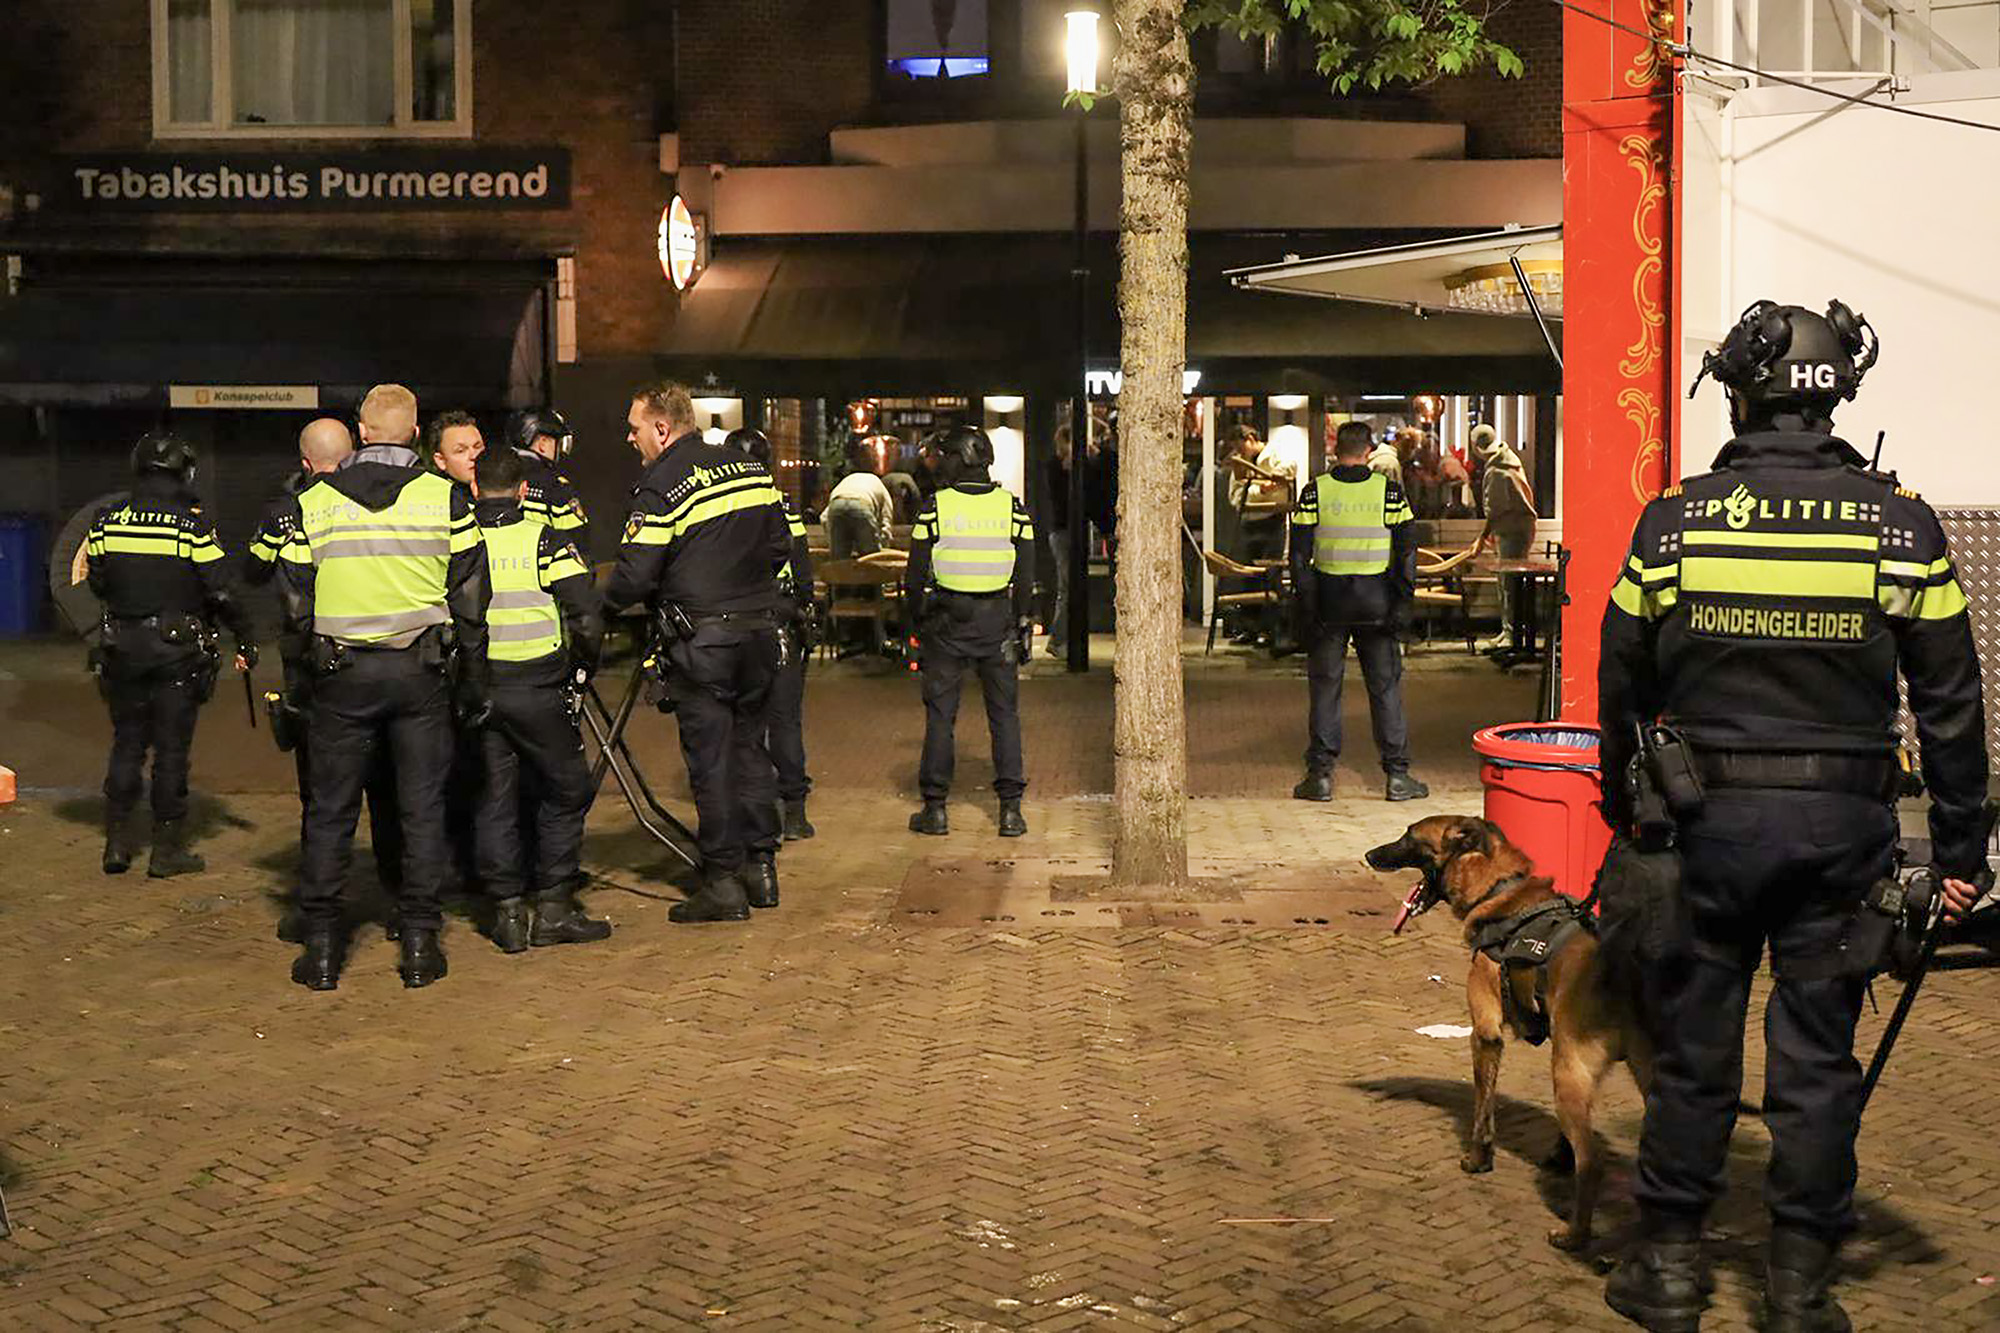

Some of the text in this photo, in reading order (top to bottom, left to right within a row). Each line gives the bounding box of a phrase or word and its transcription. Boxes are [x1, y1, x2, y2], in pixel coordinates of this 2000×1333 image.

[75, 164, 548, 198] Tabakshuis Purmerend
[1791, 364, 1835, 388] HG
[687, 462, 746, 486] POLITIE
[113, 507, 172, 525] POLITIE
[1705, 493, 1857, 529] POLITIE
[492, 556, 531, 571] ITIE
[1690, 603, 1863, 639] HONDENGELEIDER
